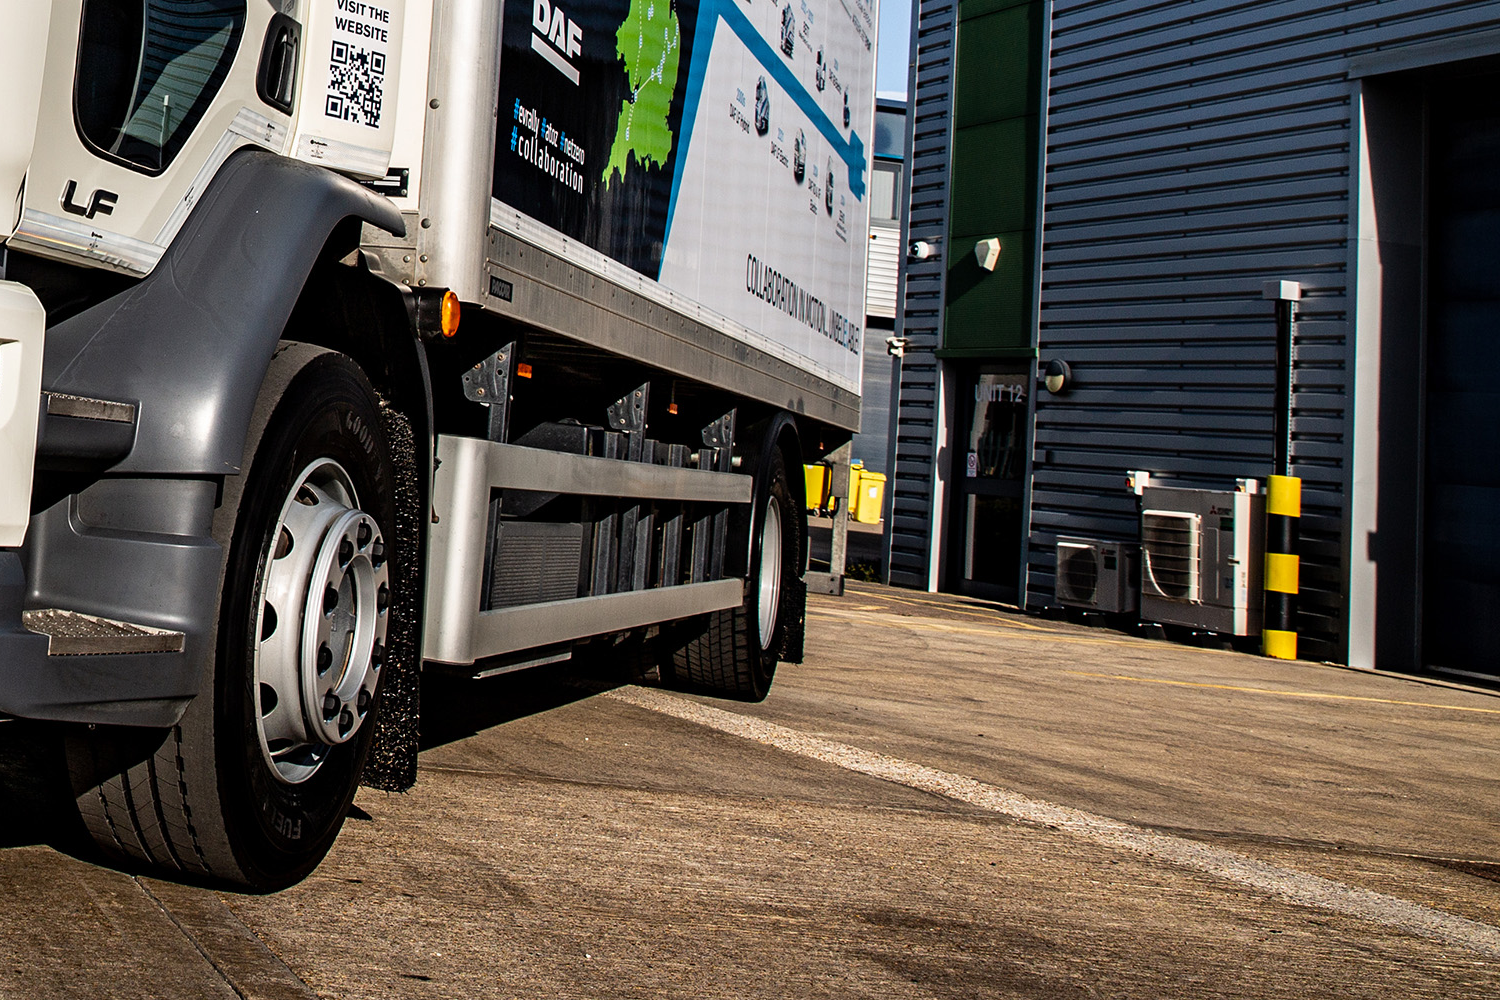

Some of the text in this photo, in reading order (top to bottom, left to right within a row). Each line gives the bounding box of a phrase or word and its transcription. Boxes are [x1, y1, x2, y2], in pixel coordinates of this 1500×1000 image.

[334, 16, 388, 43] WEBSITE
[368, 6, 390, 24] THE
[513, 97, 540, 140] #evrally
[559, 131, 585, 166] #netzero
[60, 179, 119, 220] LF
[746, 253, 799, 319] COLLABORATION
[974, 383, 1023, 403] UNIT 12
